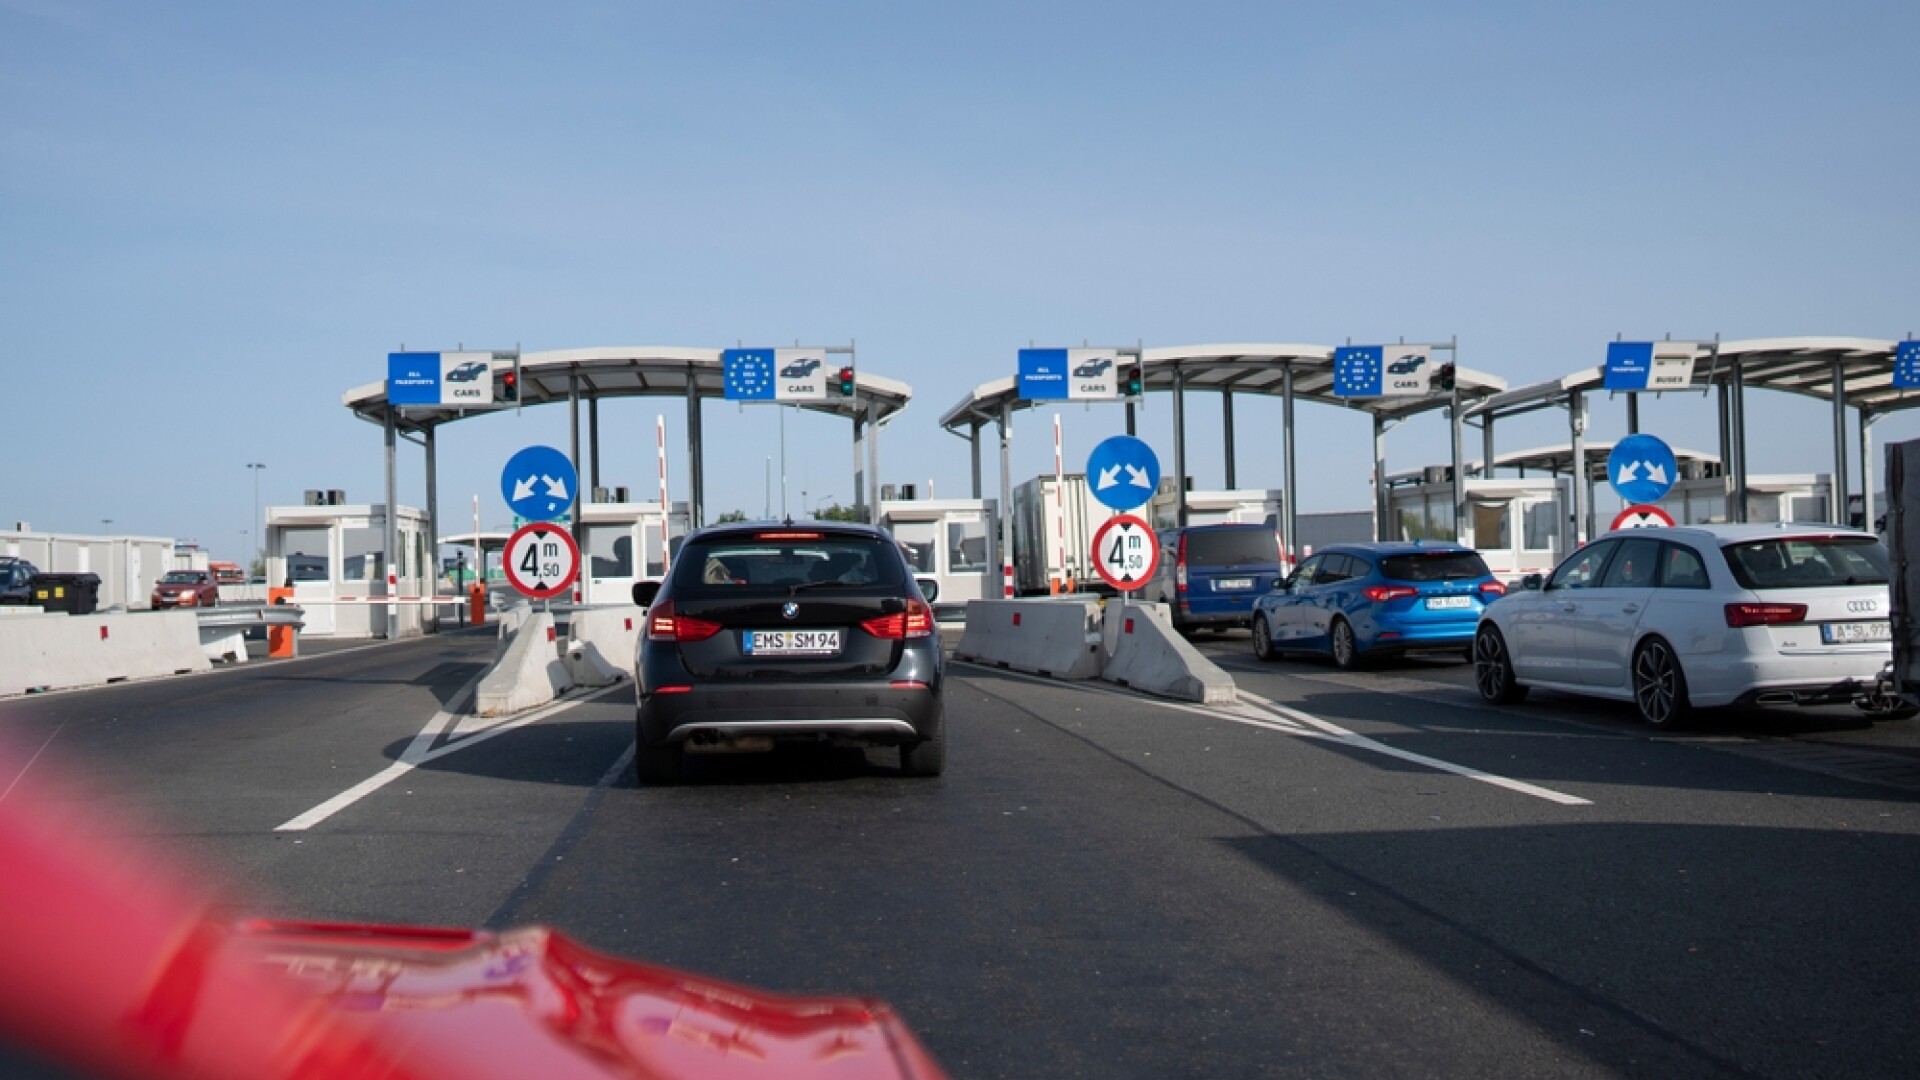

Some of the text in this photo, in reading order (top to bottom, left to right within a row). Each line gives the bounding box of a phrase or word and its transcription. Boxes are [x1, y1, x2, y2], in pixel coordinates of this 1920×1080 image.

[453, 389, 480, 397] CARS
[1080, 384, 1106, 392] CARS
[1129, 535, 1141, 549] m
[543, 543, 558, 557] m
[1108, 535, 1124, 568] 4
[520, 543, 538, 576] 4
[817, 632, 838, 649] 94
